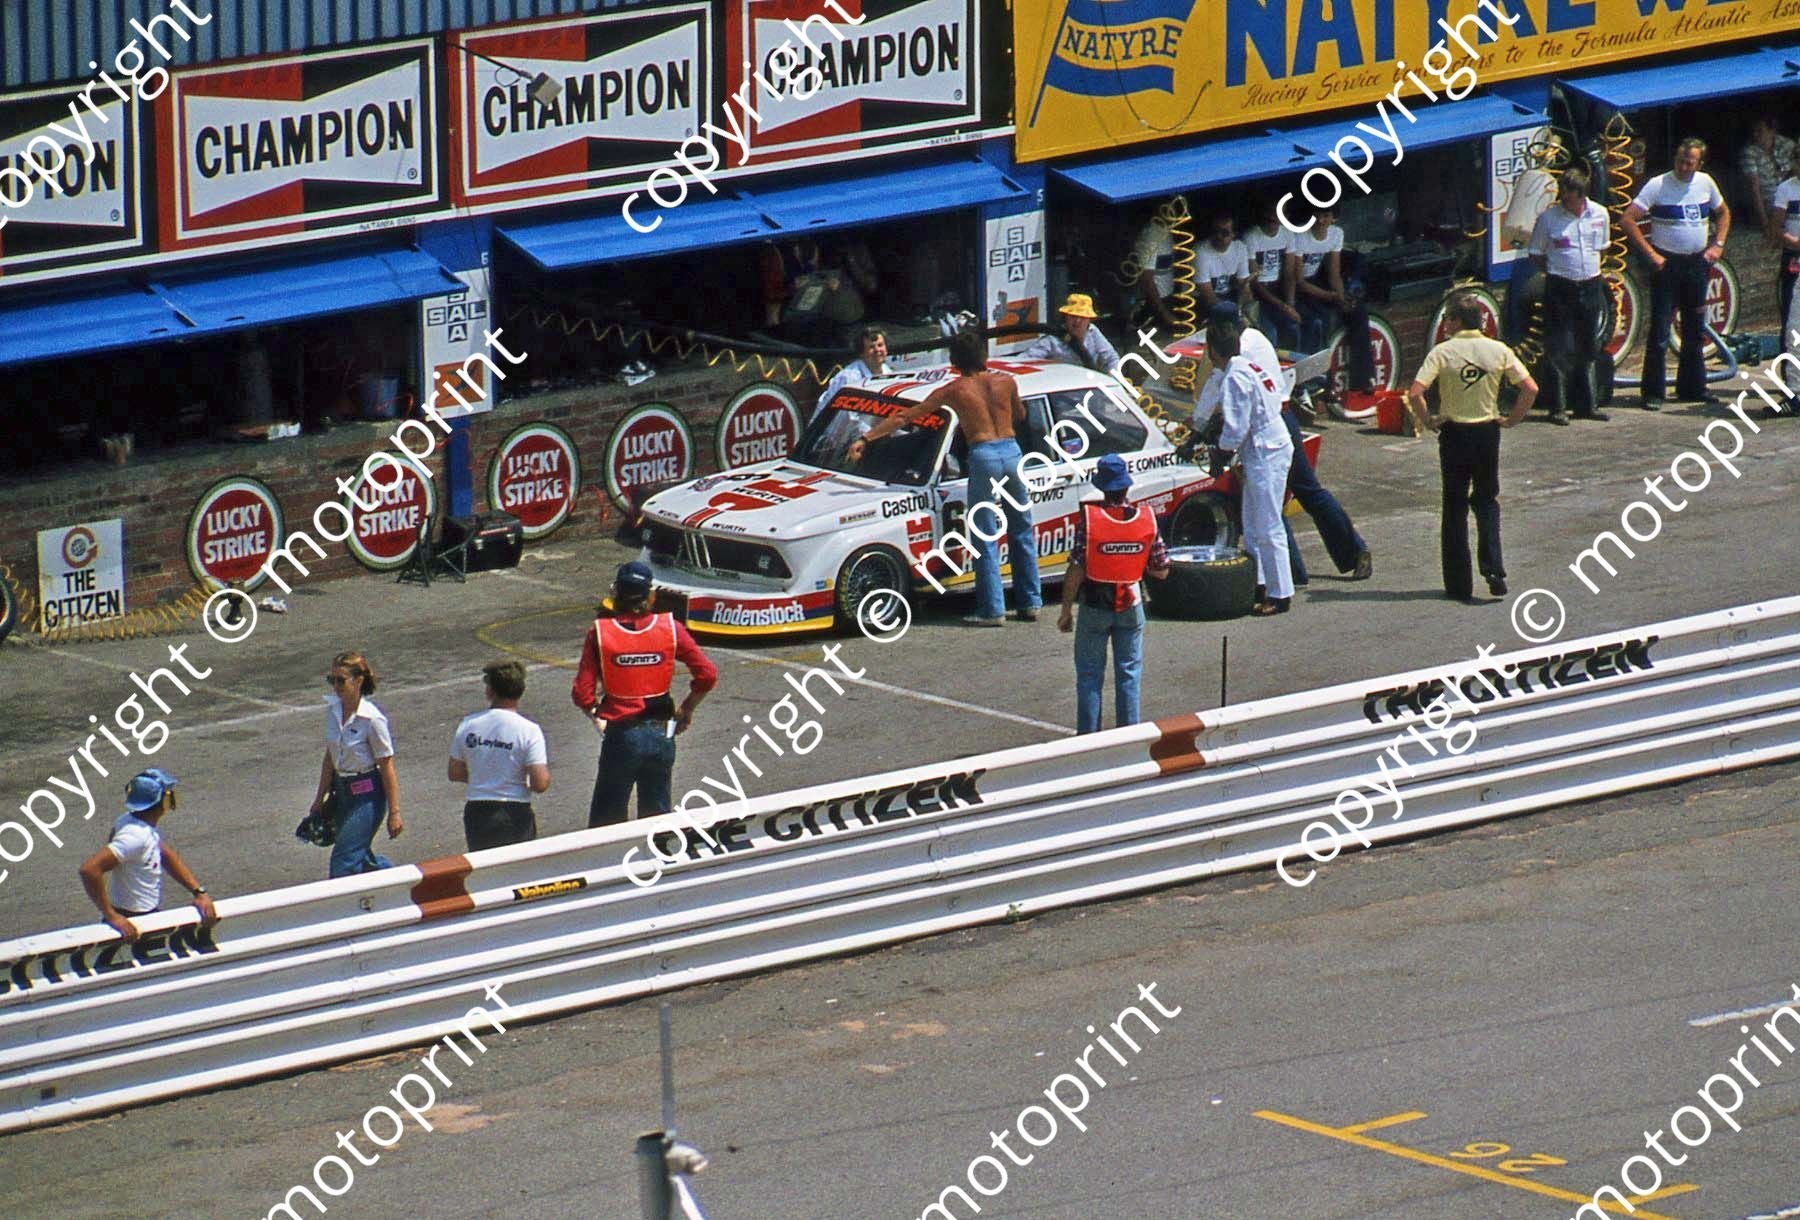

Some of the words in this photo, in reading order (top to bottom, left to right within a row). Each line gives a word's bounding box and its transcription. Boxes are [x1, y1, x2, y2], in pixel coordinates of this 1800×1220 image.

[1064, 25, 1182, 59] NATYRE
[1317, 73, 1382, 100] Service
[1506, 44, 1525, 64] to
[1538, 38, 1563, 57] the
[1571, 21, 1656, 57] Formula
[1664, 8, 1751, 37] Atlantic
[764, 22, 959, 99] CHAMPION
[483, 59, 690, 137] CHAMPION
[196, 99, 414, 178] CHAMPION
[0, 139, 117, 204] PION
[734, 407, 784, 438] LUCKY
[624, 429, 676, 460] LUCKY
[731, 434, 787, 466] STRIKE
[507, 448, 560, 479] LUCKY
[621, 456, 678, 487] STRIKE
[505, 477, 564, 507] STRIKE
[882, 492, 929, 519] Castrol
[206, 503, 263, 536] LUCKY
[359, 505, 420, 538] STRIKE
[203, 531, 267, 564] STRIKE
[63, 569, 96, 594] THE
[45, 589, 120, 628] CITIZEN
[712, 599, 806, 626] Rodenstock
[478, 735, 514, 751] Leyland
[763, 768, 987, 843] CITIZEN
[517, 880, 581, 899] Valvoline
[0, 917, 220, 996] ITIZEN
